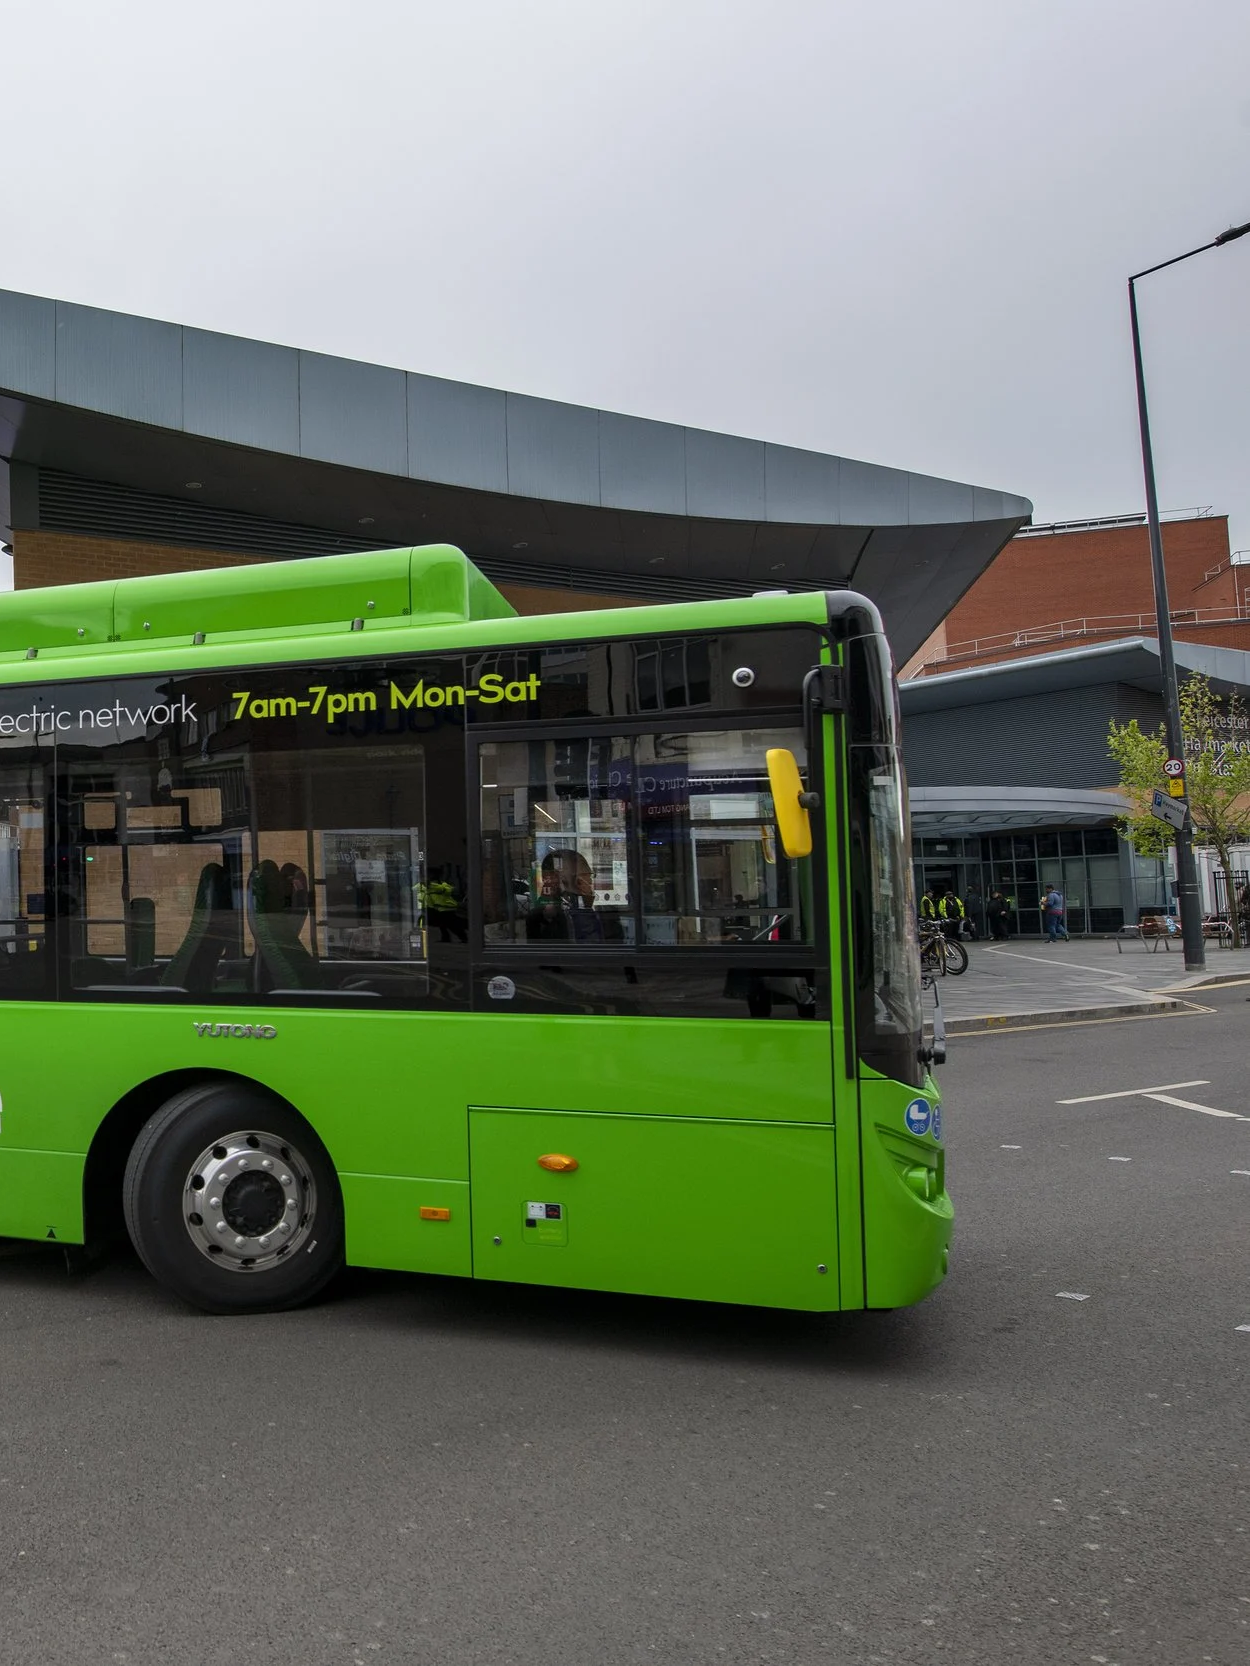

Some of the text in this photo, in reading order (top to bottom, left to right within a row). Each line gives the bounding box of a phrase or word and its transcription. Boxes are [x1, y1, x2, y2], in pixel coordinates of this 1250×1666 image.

[78, 694, 198, 729] network
[231, 673, 541, 724] 7am-7pm Mon-Sat
[1166, 763, 1181, 772] 20
[193, 1022, 277, 1039] YUTONG
